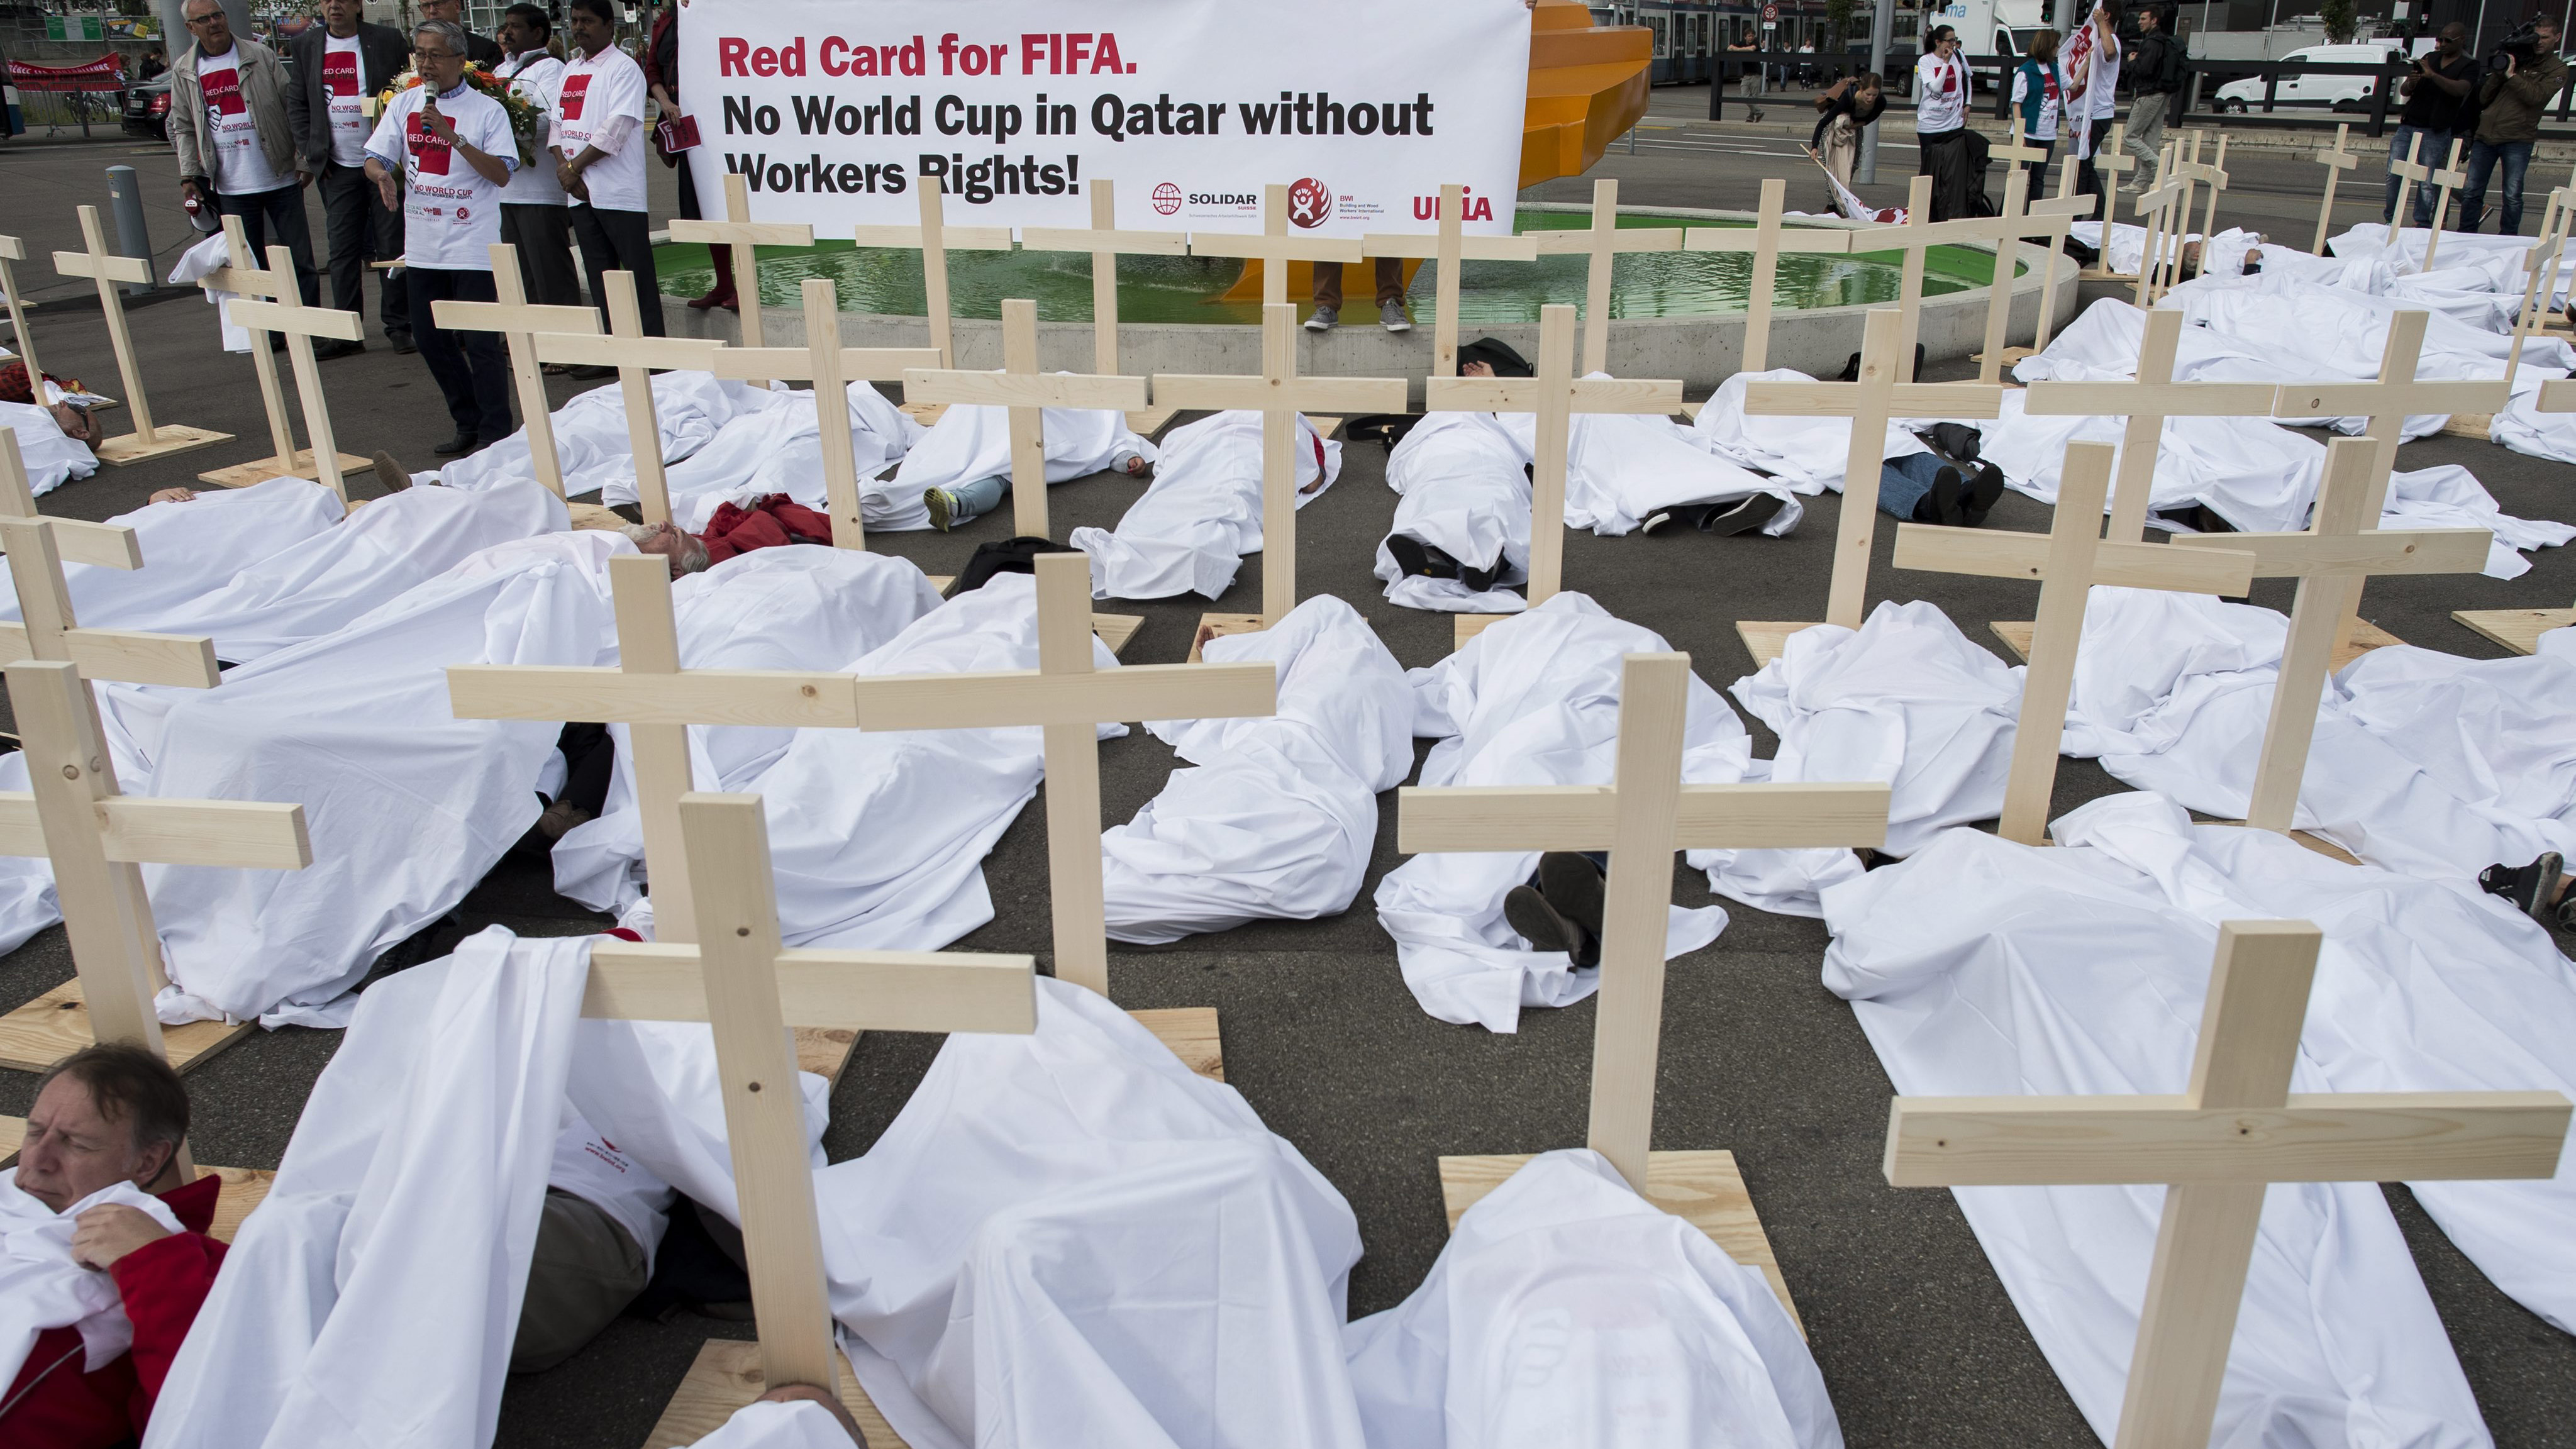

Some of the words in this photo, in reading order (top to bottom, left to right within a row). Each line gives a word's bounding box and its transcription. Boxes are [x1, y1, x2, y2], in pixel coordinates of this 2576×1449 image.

[719, 36, 806, 77] Red
[820, 35, 926, 76] Card
[938, 33, 1008, 75] for
[1021, 33, 1137, 75] FIFA.
[206, 88, 219, 97] RED
[219, 84, 239, 93] CARD
[723, 96, 780, 135] No
[791, 96, 921, 135] World
[935, 94, 1022, 144] Cup
[1036, 94, 1077, 135] in
[1091, 94, 1226, 142] Qatar
[1239, 92, 1434, 135] without
[409, 133, 423, 143] RED
[724, 153, 907, 194] Workers
[919, 153, 1079, 204] Rights!
[425, 186, 455, 195] WORLD
[1189, 194, 1257, 204] SOLIDAR
